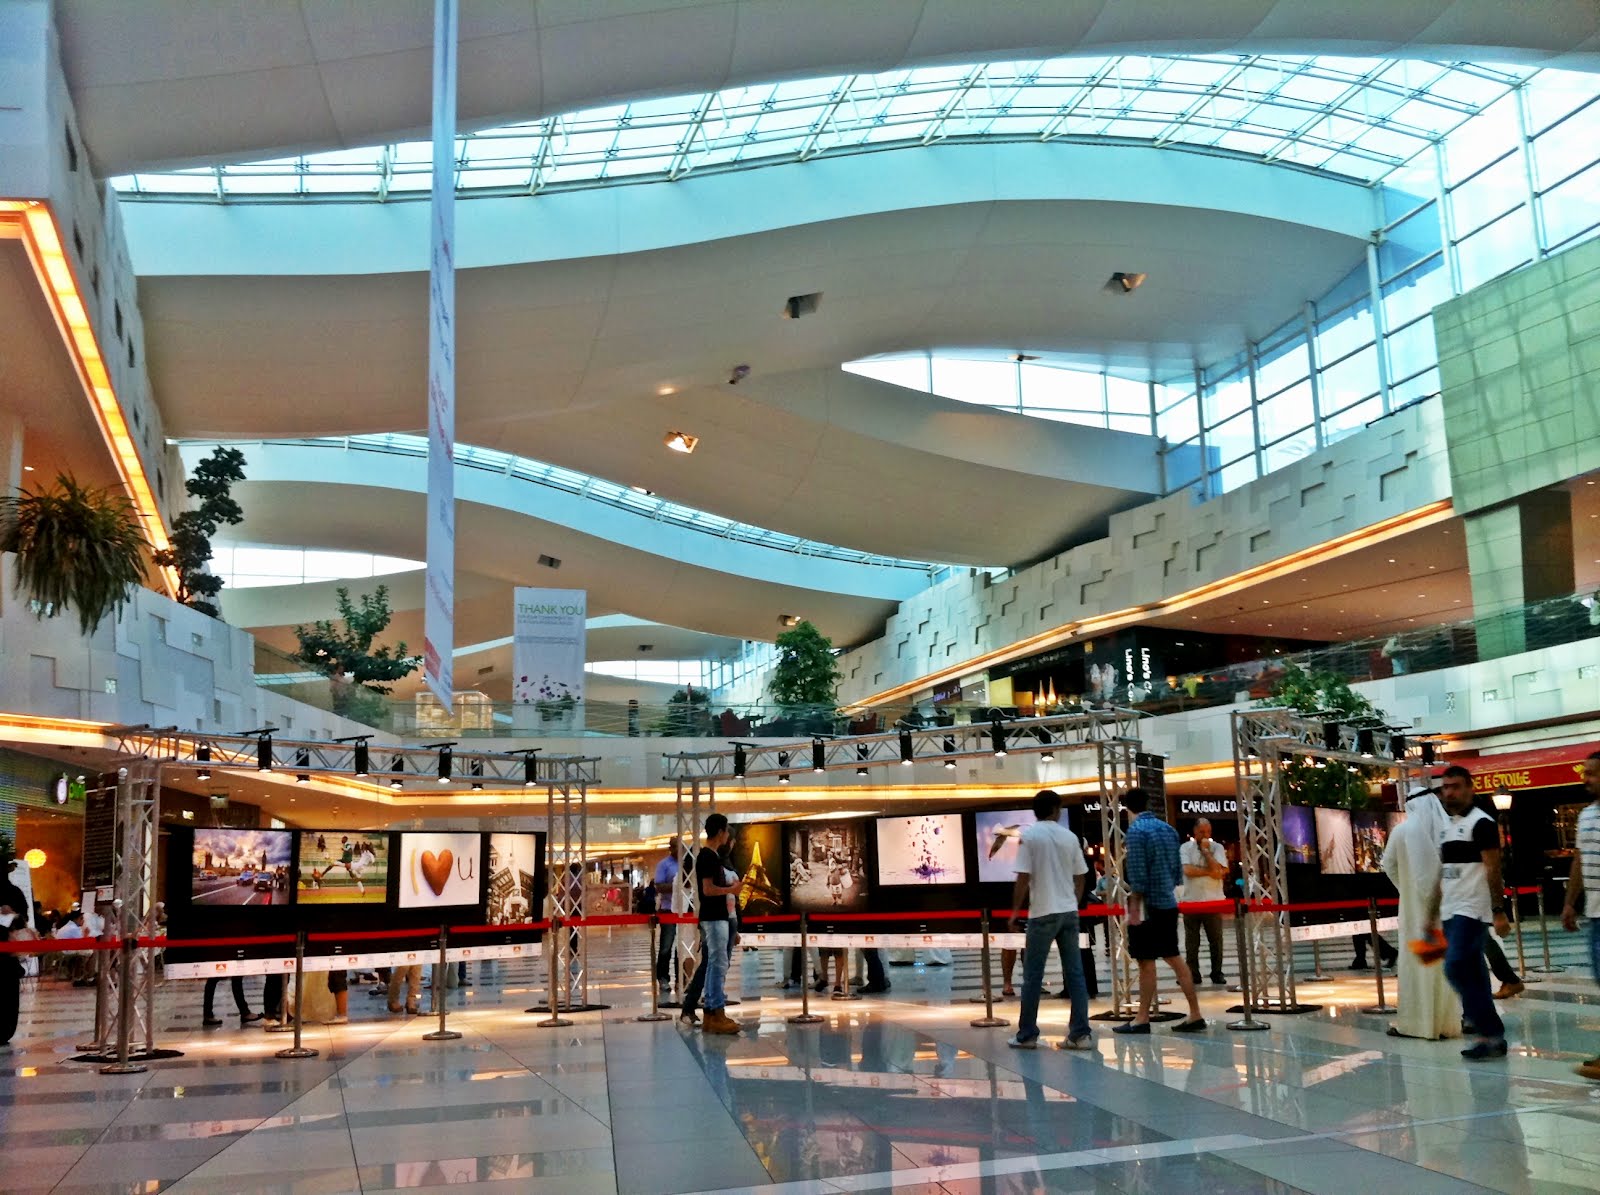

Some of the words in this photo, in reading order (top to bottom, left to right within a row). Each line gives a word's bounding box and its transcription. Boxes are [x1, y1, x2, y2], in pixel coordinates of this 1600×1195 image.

[518, 603, 558, 615] THANK
[560, 605, 584, 616] YOU
[1141, 647, 1152, 680] Lino's
[1181, 799, 1221, 813] CARIBOU
